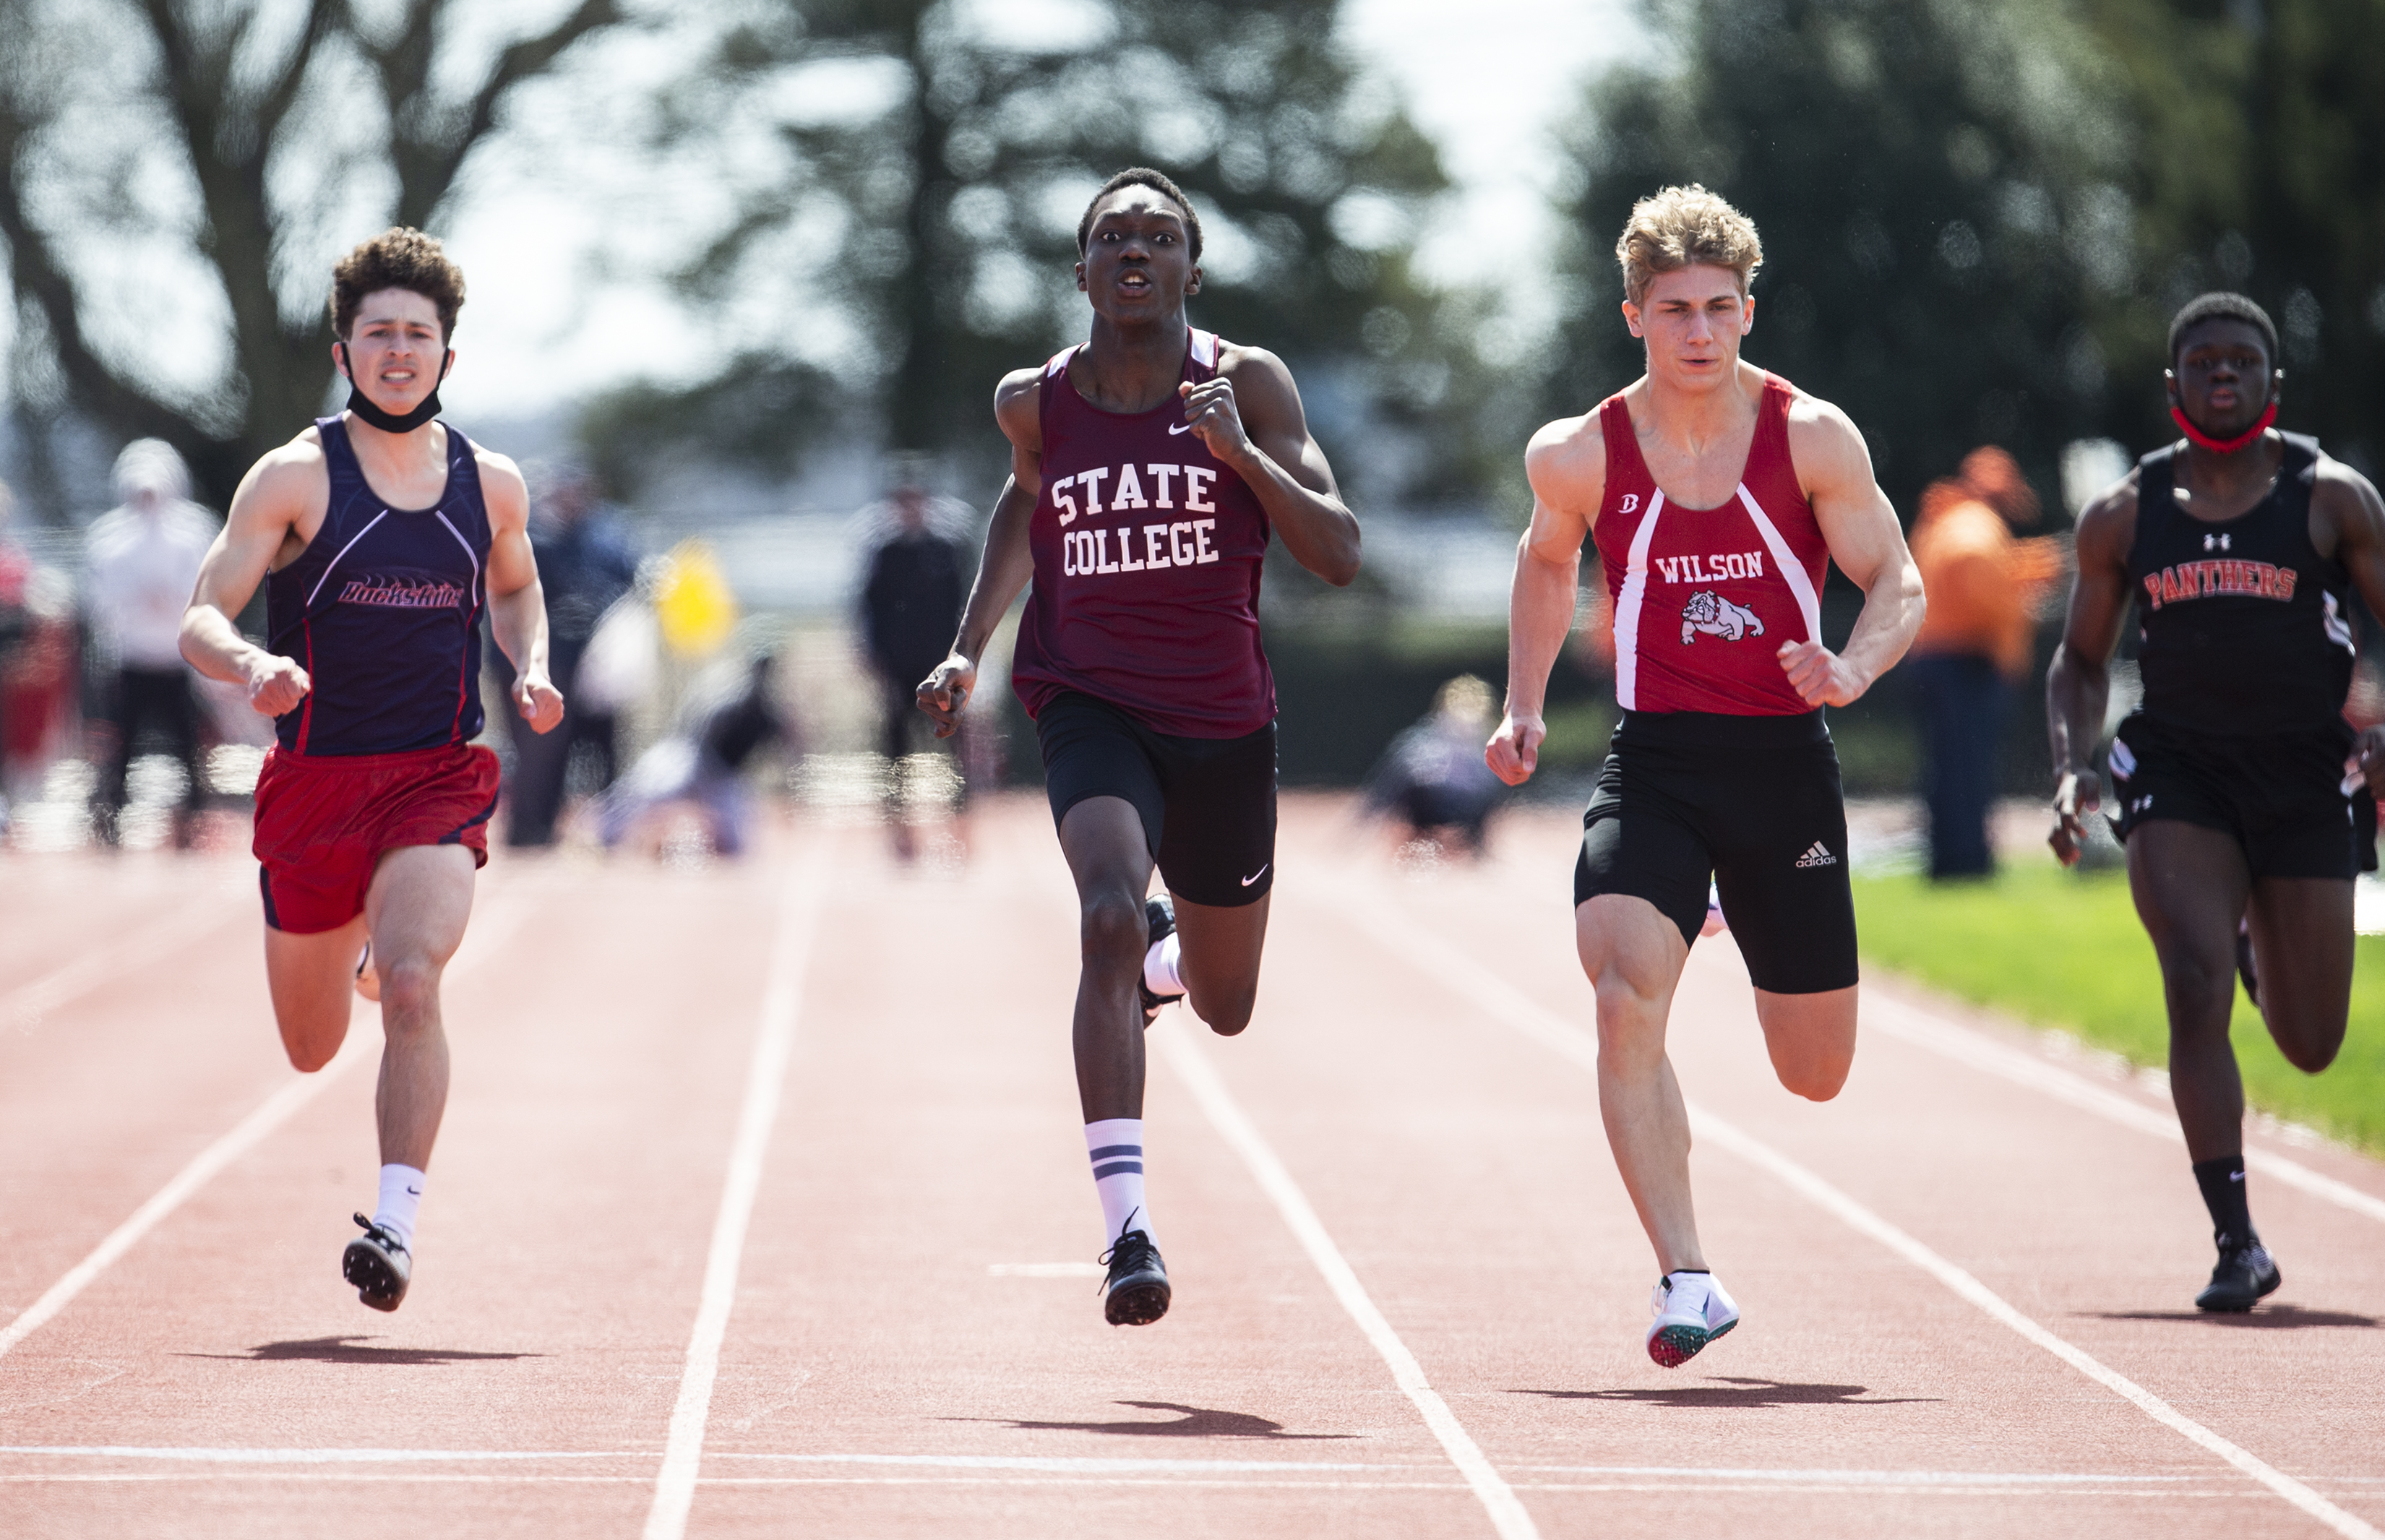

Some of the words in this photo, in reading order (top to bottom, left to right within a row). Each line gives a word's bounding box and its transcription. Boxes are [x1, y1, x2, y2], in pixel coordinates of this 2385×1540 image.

[1052, 463, 1216, 527] STATE
[1064, 518, 1219, 577] COLLEGE
[1655, 551, 1763, 584] WILSON
[2144, 559, 2298, 611] PANTHERS
[1795, 856, 1836, 868] adidas
